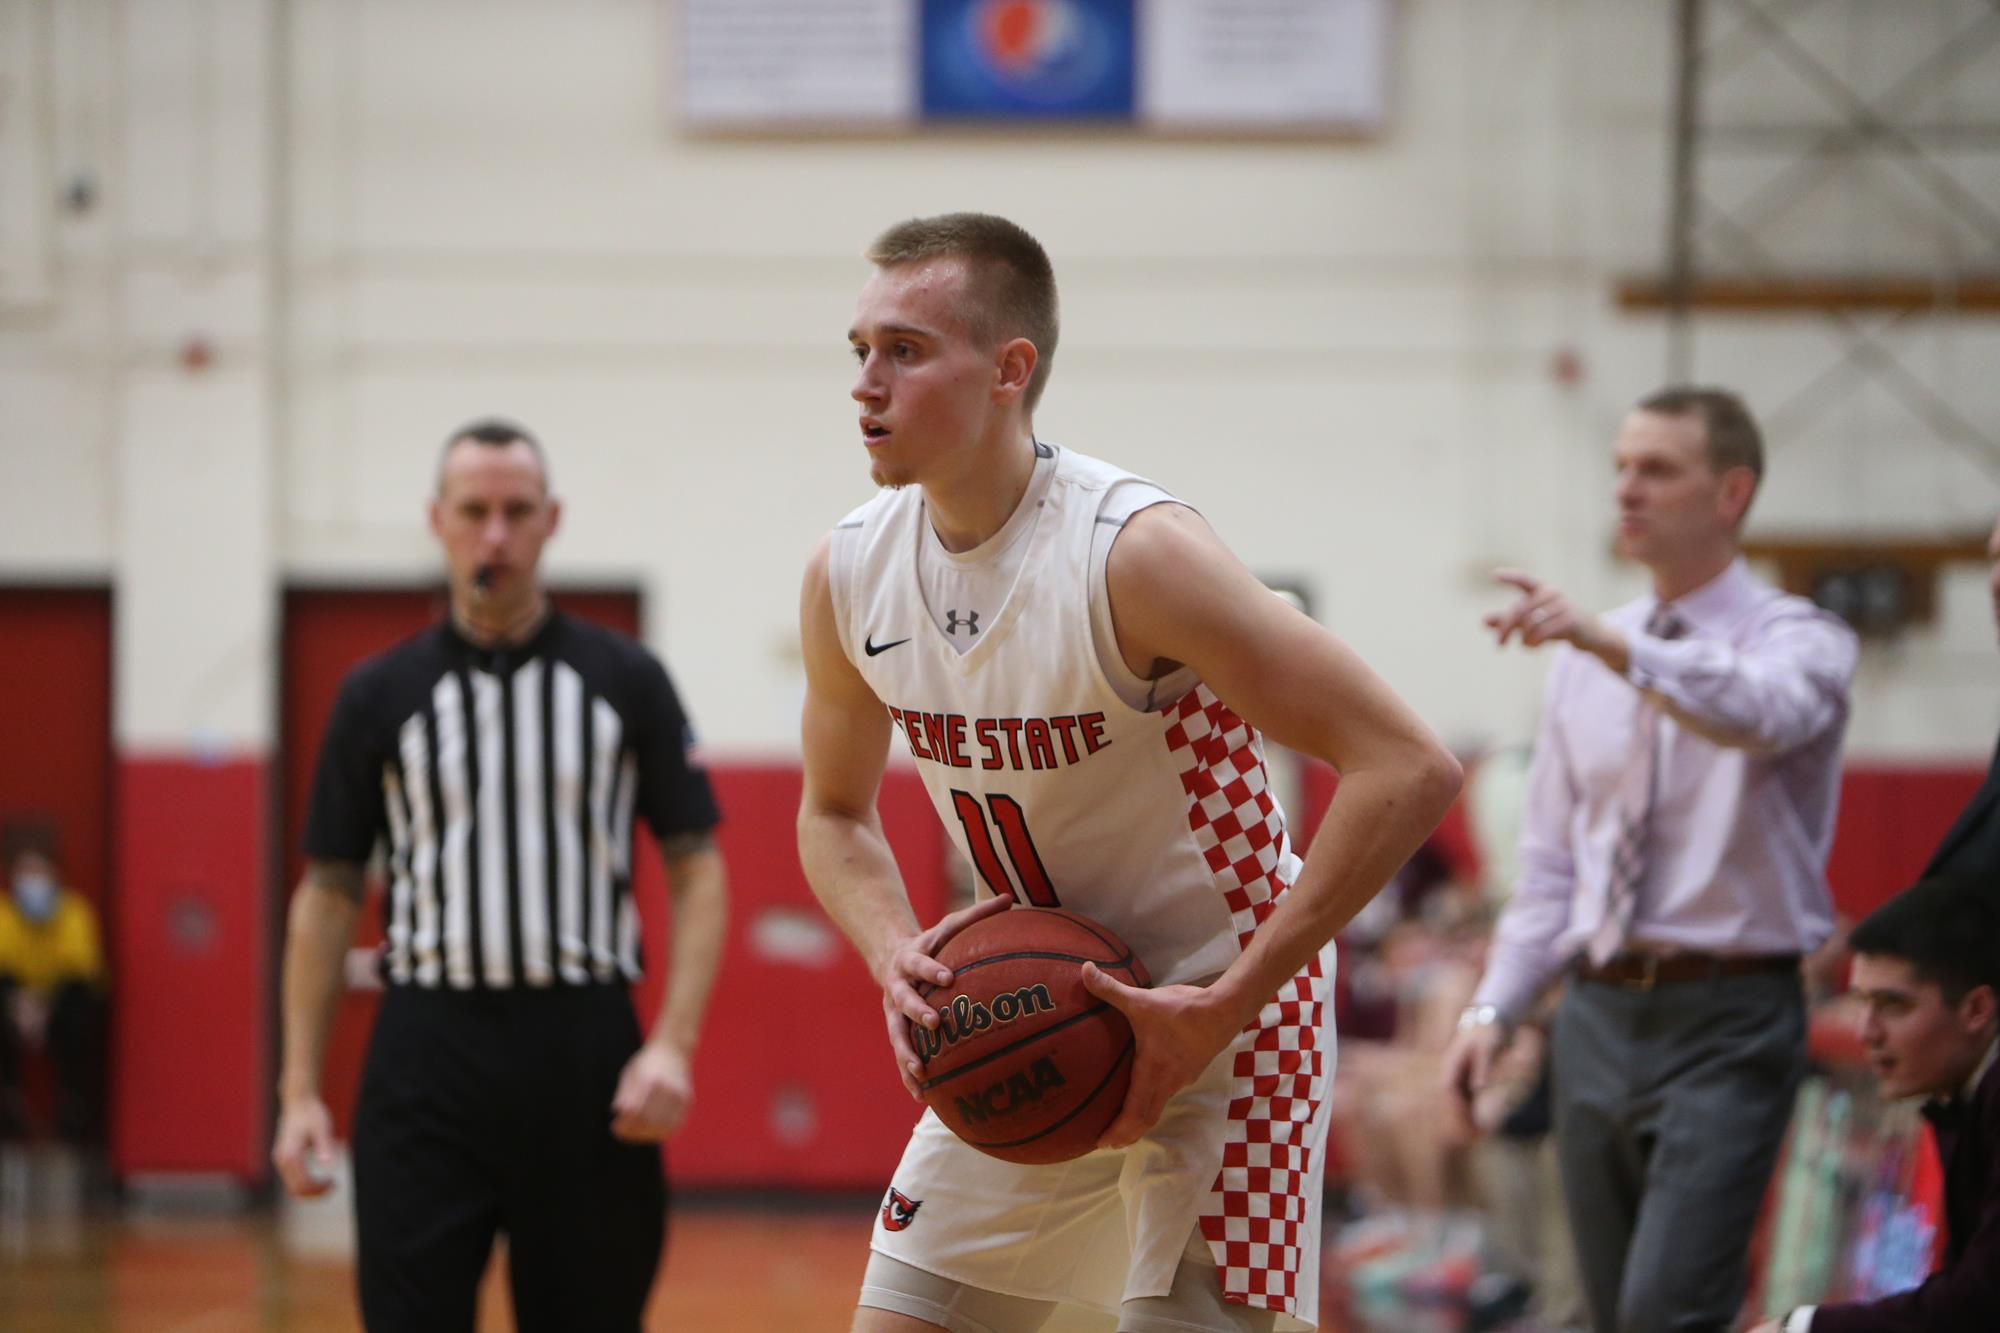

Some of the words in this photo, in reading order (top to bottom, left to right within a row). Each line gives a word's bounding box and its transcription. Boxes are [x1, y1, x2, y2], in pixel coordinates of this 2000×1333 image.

[974, 711, 1112, 770] STATE
[949, 788, 1062, 908] 11
[914, 983, 1056, 1065] Wilson
[954, 1055, 1067, 1125] NCAA
